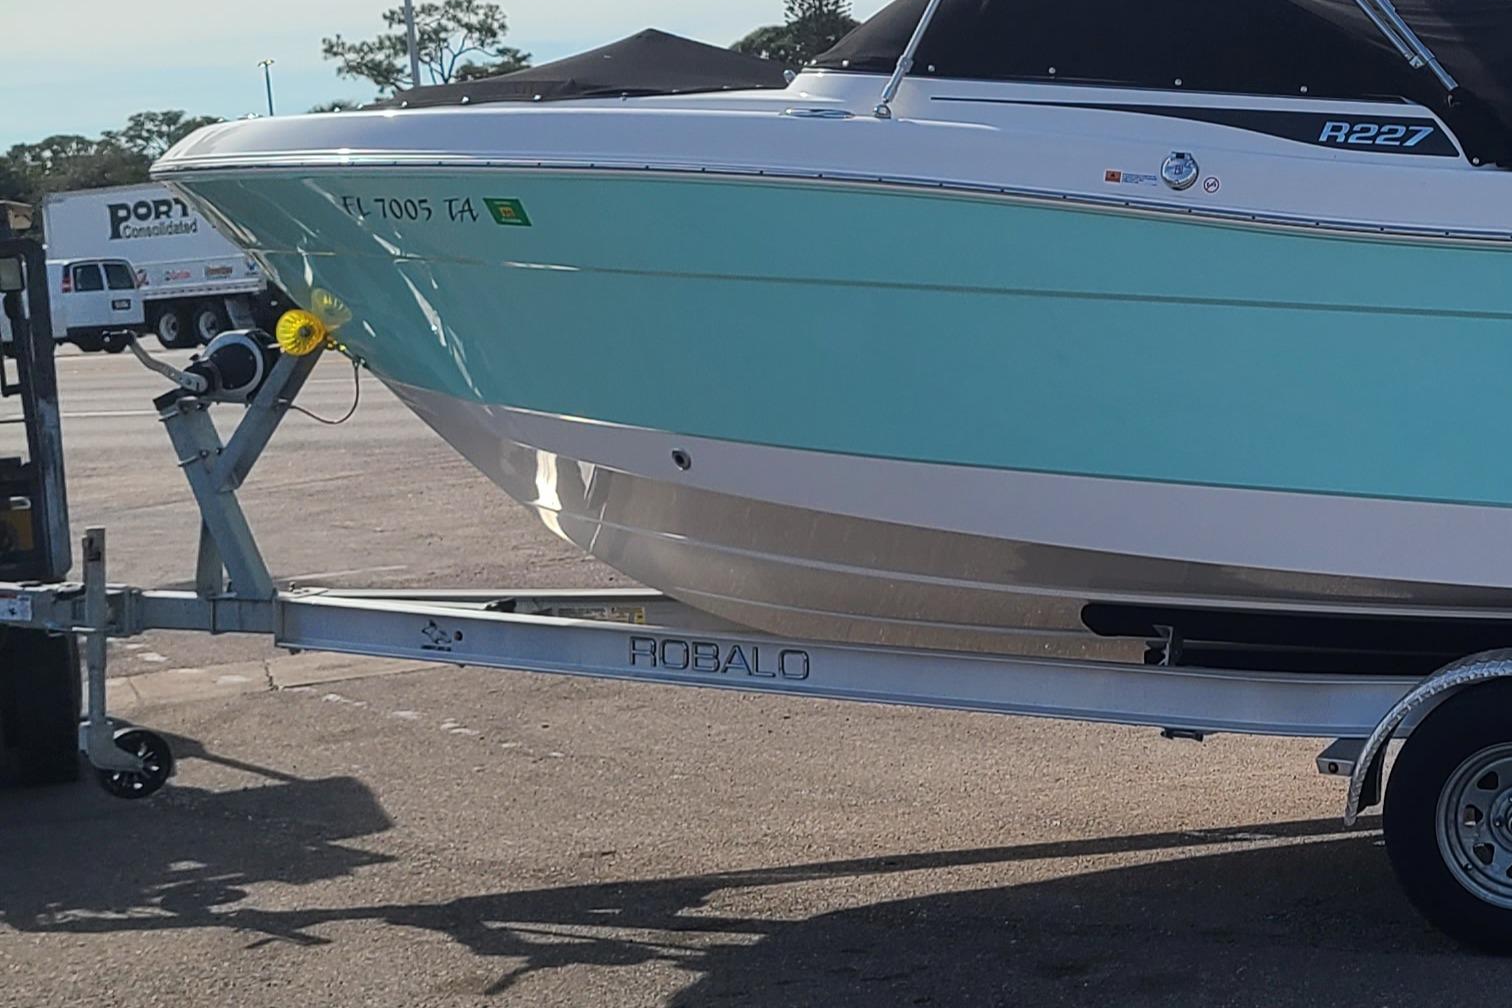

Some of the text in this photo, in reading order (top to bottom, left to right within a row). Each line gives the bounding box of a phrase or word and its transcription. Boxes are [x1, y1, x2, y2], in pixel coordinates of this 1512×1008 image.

[1318, 121, 1435, 147] R227
[341, 195, 371, 218] FL
[374, 197, 433, 222] 7005
[443, 196, 480, 223] TA
[122, 218, 198, 240] Consolidated
[629, 635, 811, 681] ROBALO
